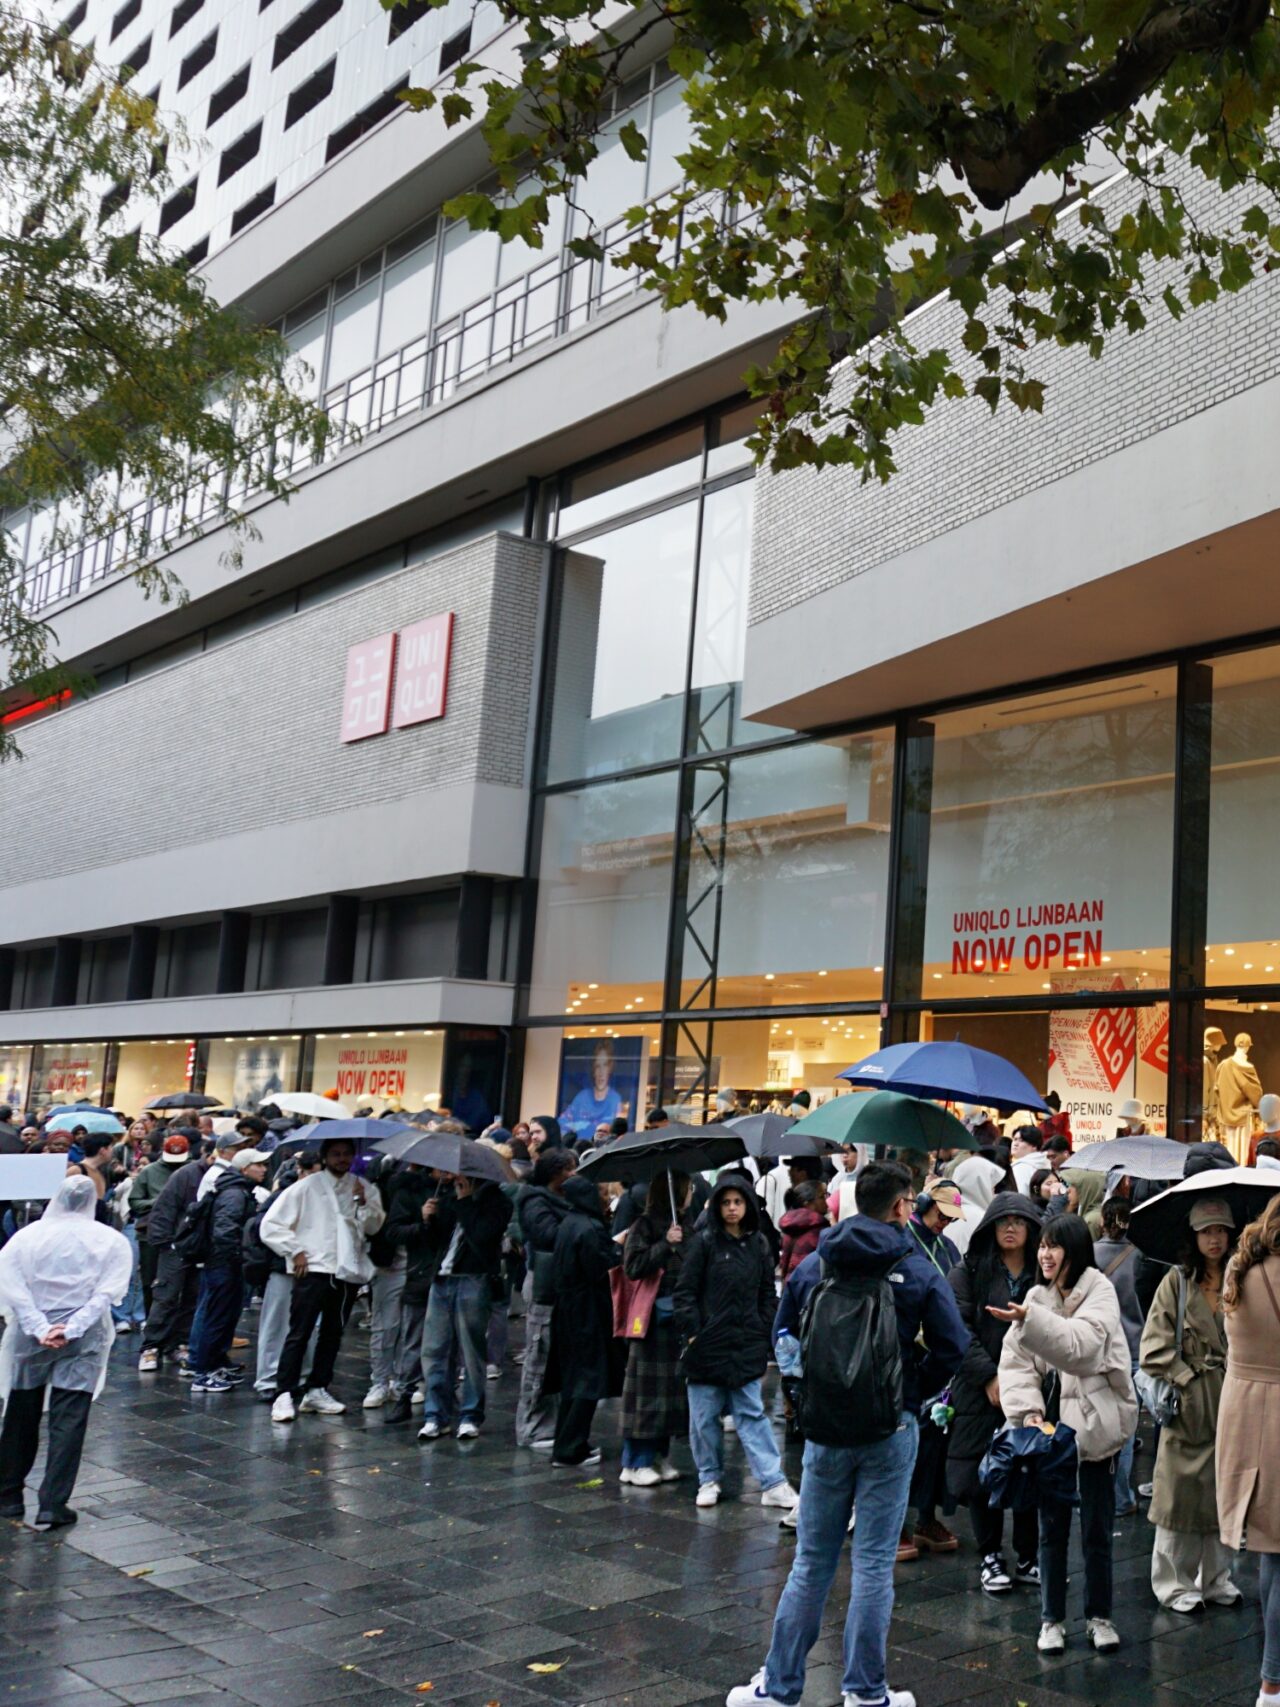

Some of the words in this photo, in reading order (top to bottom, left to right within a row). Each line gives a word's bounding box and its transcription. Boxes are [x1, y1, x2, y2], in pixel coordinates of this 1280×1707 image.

[953, 908, 1011, 934] UNIQLO
[1016, 900, 1104, 928] LIJNBAAN
[951, 936, 1016, 975] NOW
[1023, 930, 1103, 971] OPEN
[1139, 1010, 1169, 1054] OPENIN
[338, 1050, 365, 1067] UNIQLO
[336, 1070, 368, 1095] NOW
[369, 1069, 407, 1096] OPEN
[1066, 1102, 1113, 1117] OPENING
[1144, 1104, 1168, 1118] OPE
[1076, 1120, 1103, 1131] UNIQLO
